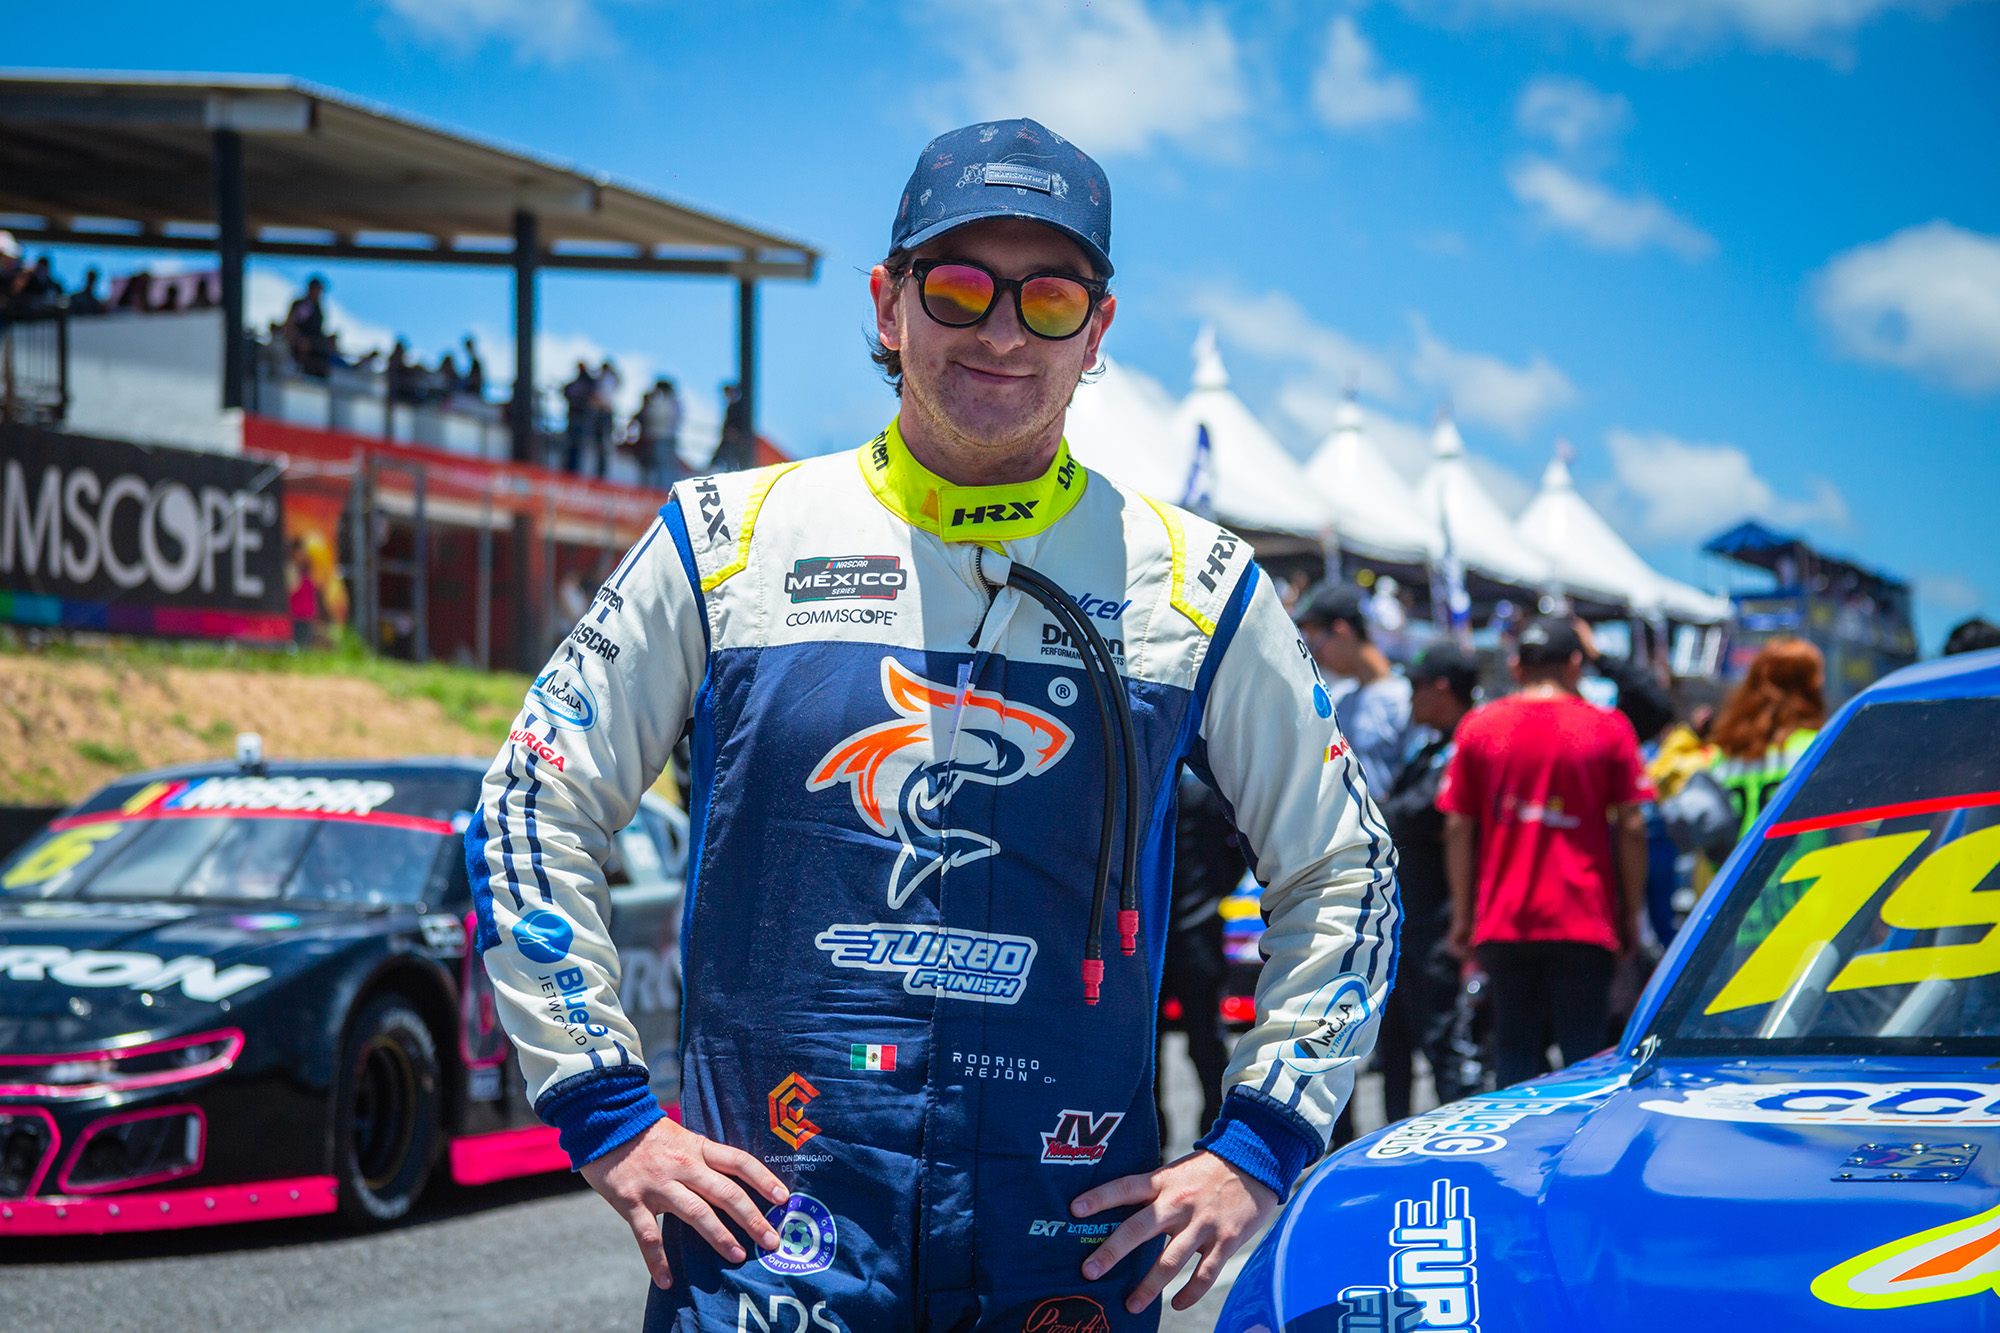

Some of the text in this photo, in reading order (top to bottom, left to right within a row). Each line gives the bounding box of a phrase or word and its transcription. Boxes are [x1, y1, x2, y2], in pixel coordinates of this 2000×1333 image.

[951, 500, 1040, 527] HRX
[836, 560, 868, 569] NASCAR
[787, 570, 904, 591] MÉXICO
[831, 587, 857, 595] SERIES
[786, 608, 897, 627] COMMSCOPE
[570, 622, 620, 664] ASCAR
[180, 776, 395, 816] NASCAR
[868, 929, 1030, 975] TURBO
[910, 969, 1021, 997] FINISH
[538, 975, 588, 1046] JETWORLD
[555, 966, 609, 1038] BlueG
[952, 1052, 1040, 1070] RODRIGO
[1028, 1219, 1067, 1237] EXT
[765, 1245, 831, 1270] PORTO PALMEIRAS
